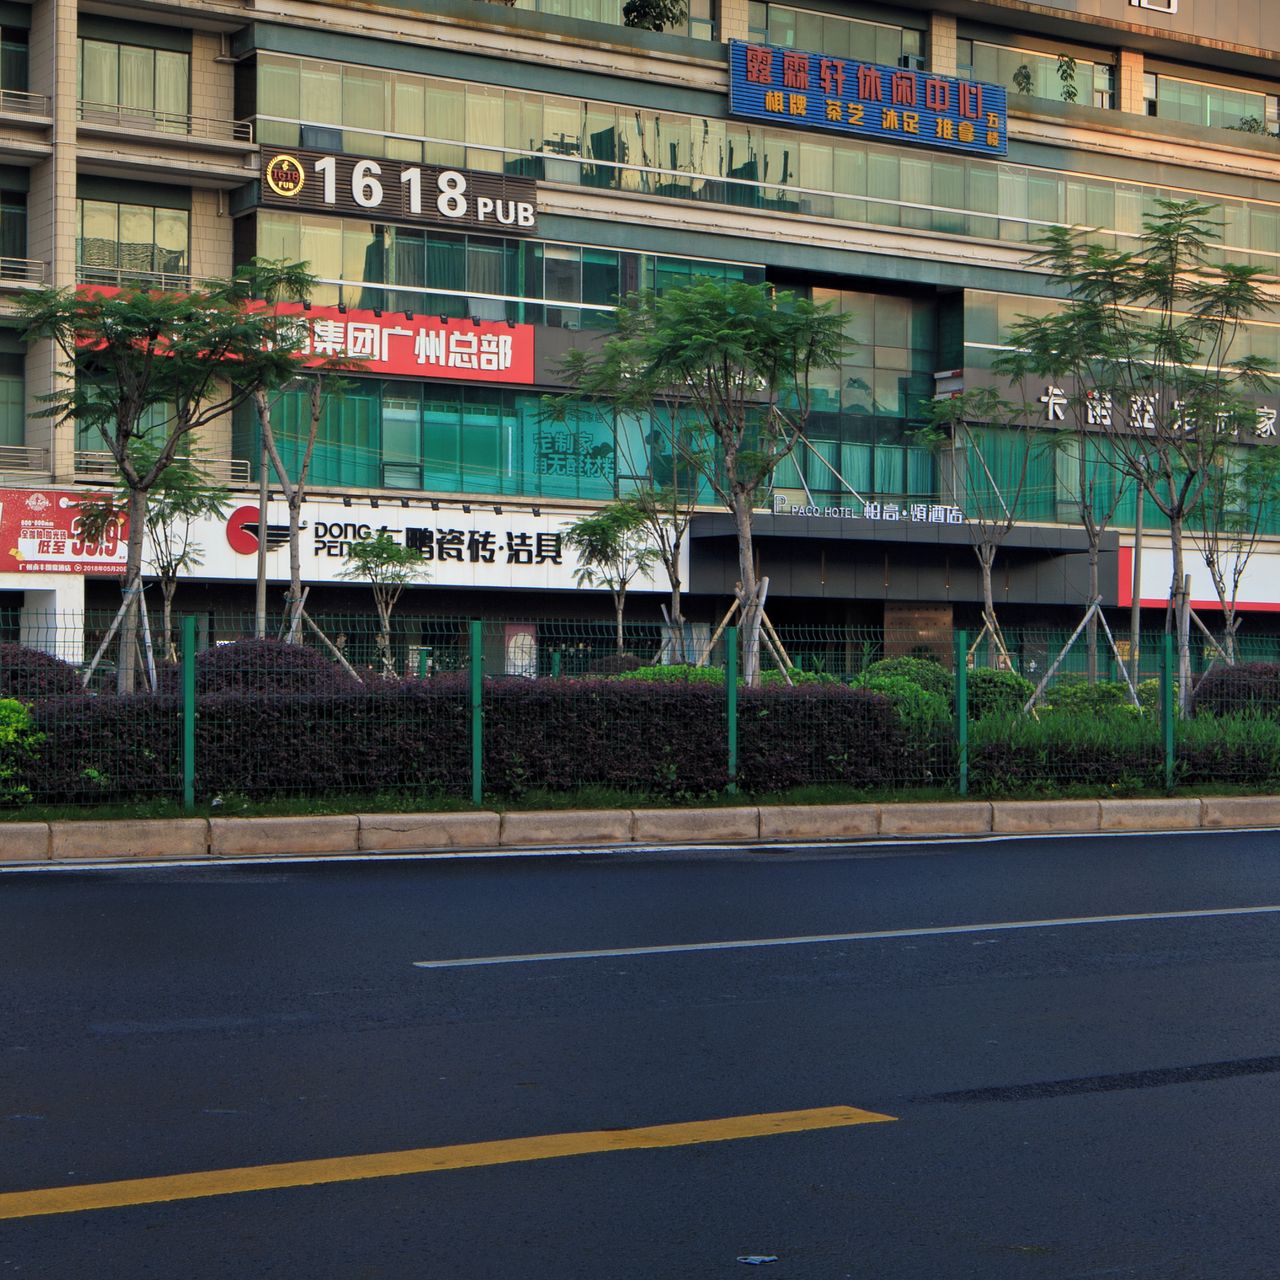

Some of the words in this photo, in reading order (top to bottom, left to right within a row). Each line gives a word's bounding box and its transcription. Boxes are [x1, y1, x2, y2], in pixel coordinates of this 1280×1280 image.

[764, 90, 808, 117] 棋牌
[825, 98, 865, 126] 茶艺
[881, 107, 919, 133] 沐足
[935, 117, 975, 143] 推拿
[986, 111, 1001, 148] 五楼
[314, 155, 468, 218] 1618
[476, 197, 535, 227] PUB
[533, 430, 602, 455] 定制家
[791, 505, 821, 517] PACO
[824, 506, 858, 519] HOTEL
[314, 522, 372, 541] DONG
[37, 540, 66, 554] 低至
[314, 540, 362, 557] PEN
